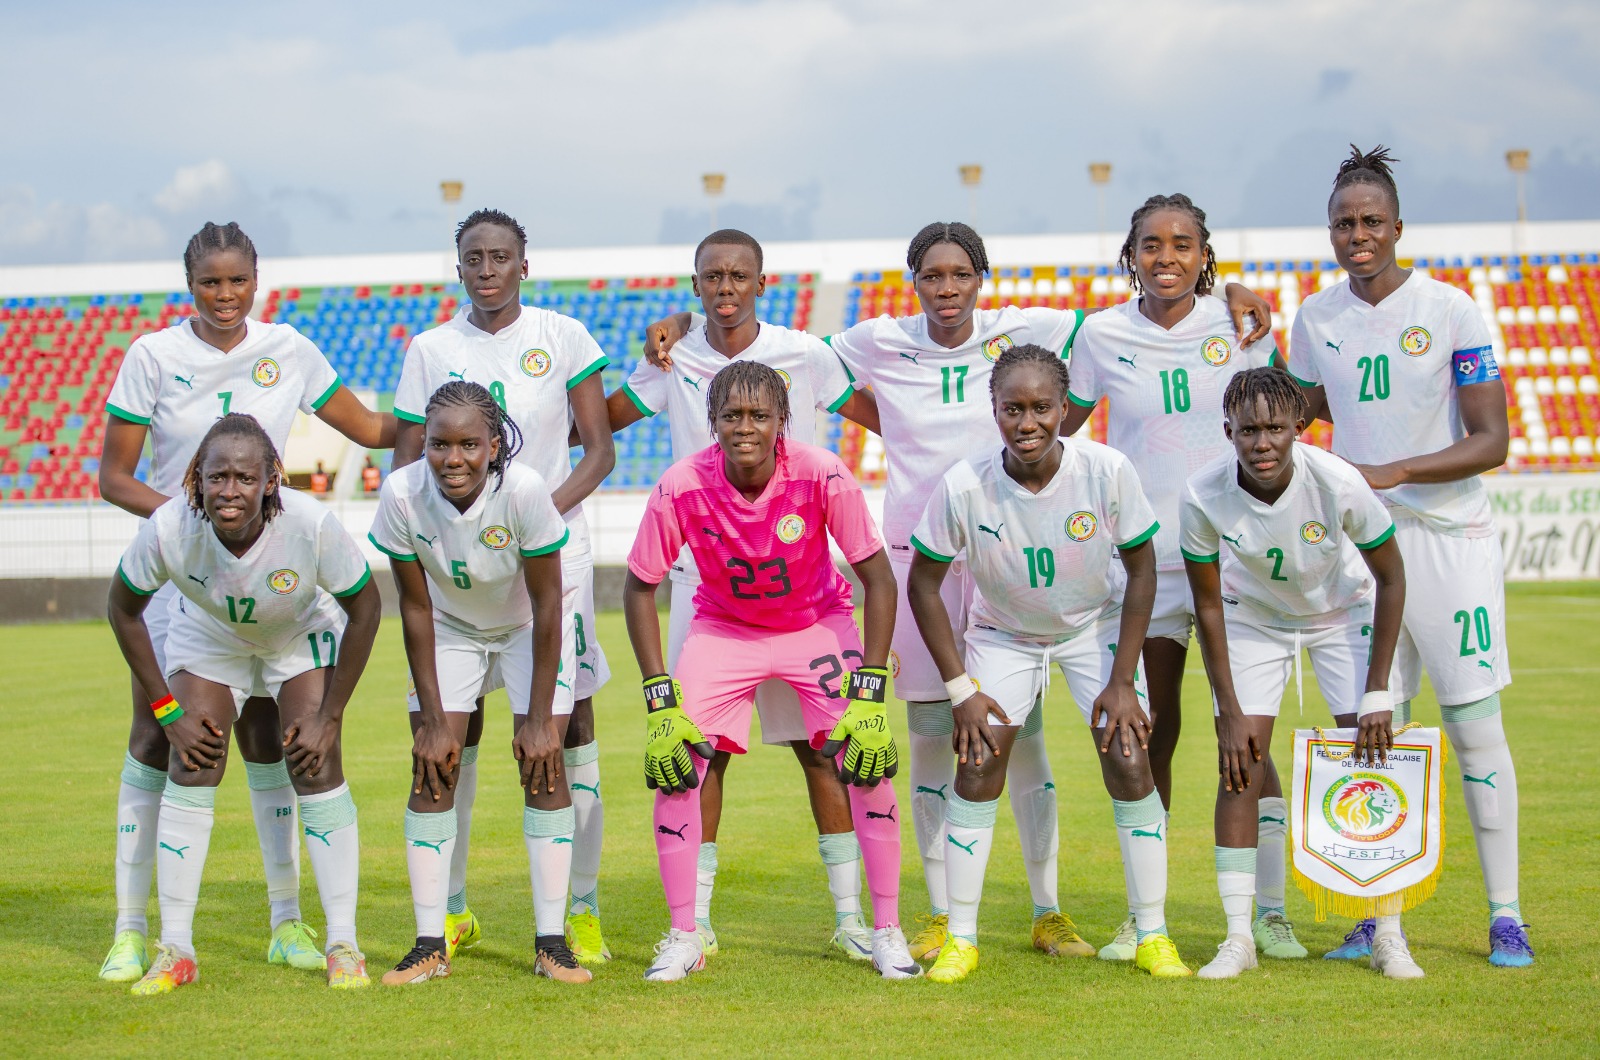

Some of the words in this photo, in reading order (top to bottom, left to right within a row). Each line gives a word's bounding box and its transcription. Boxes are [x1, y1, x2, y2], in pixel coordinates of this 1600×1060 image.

[940, 365, 969, 404] 17
[1159, 368, 1191, 414] 18
[1358, 353, 1391, 402] 20
[217, 391, 233, 416] 7
[451, 559, 472, 590] 5
[726, 557, 792, 599] 23
[1023, 547, 1056, 589] 19
[1267, 547, 1288, 582] 2
[225, 595, 257, 624] 12
[1453, 606, 1492, 657] 20
[862, 675, 882, 690] ADJI
[855, 714, 886, 733] Loxo
[1341, 760, 1353, 768] DE
[1354, 761, 1395, 770] FOOBALL
[276, 805, 293, 818] FSF
[120, 824, 137, 833] FSF
[1348, 850, 1381, 859] F.S.F
